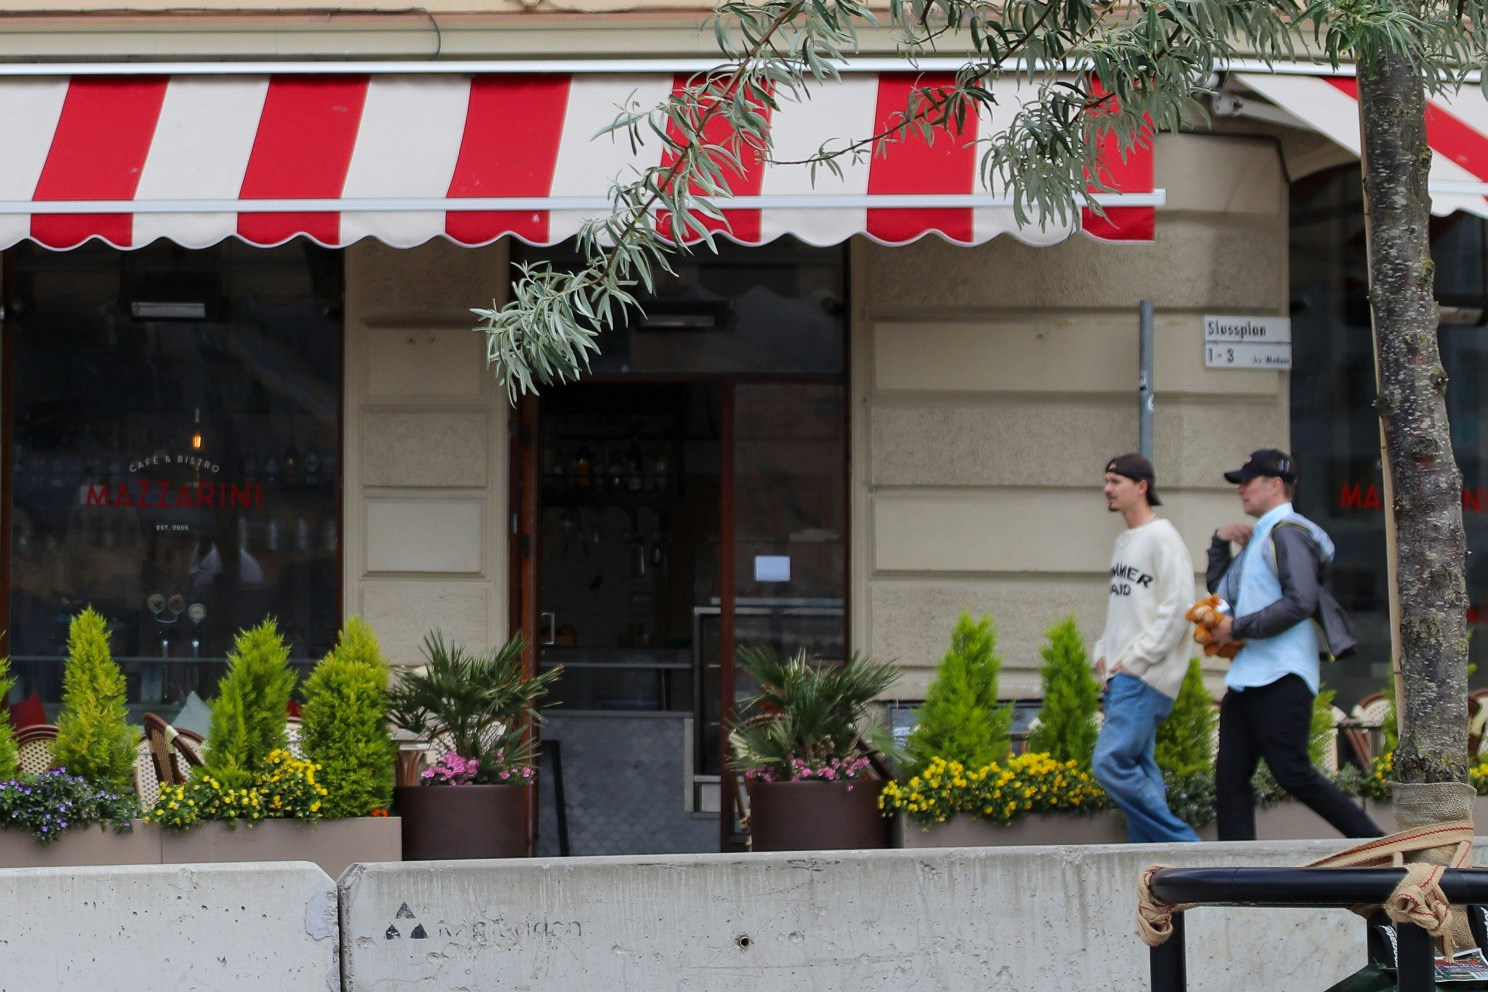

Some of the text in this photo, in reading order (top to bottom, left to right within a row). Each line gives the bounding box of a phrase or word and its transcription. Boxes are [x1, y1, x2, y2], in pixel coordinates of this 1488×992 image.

[1207, 320, 1266, 340] Slussplan
[129, 455, 159, 472] CAFÉ
[177, 455, 220, 473] BISTRO
[85, 480, 263, 509] MAZZARINI
